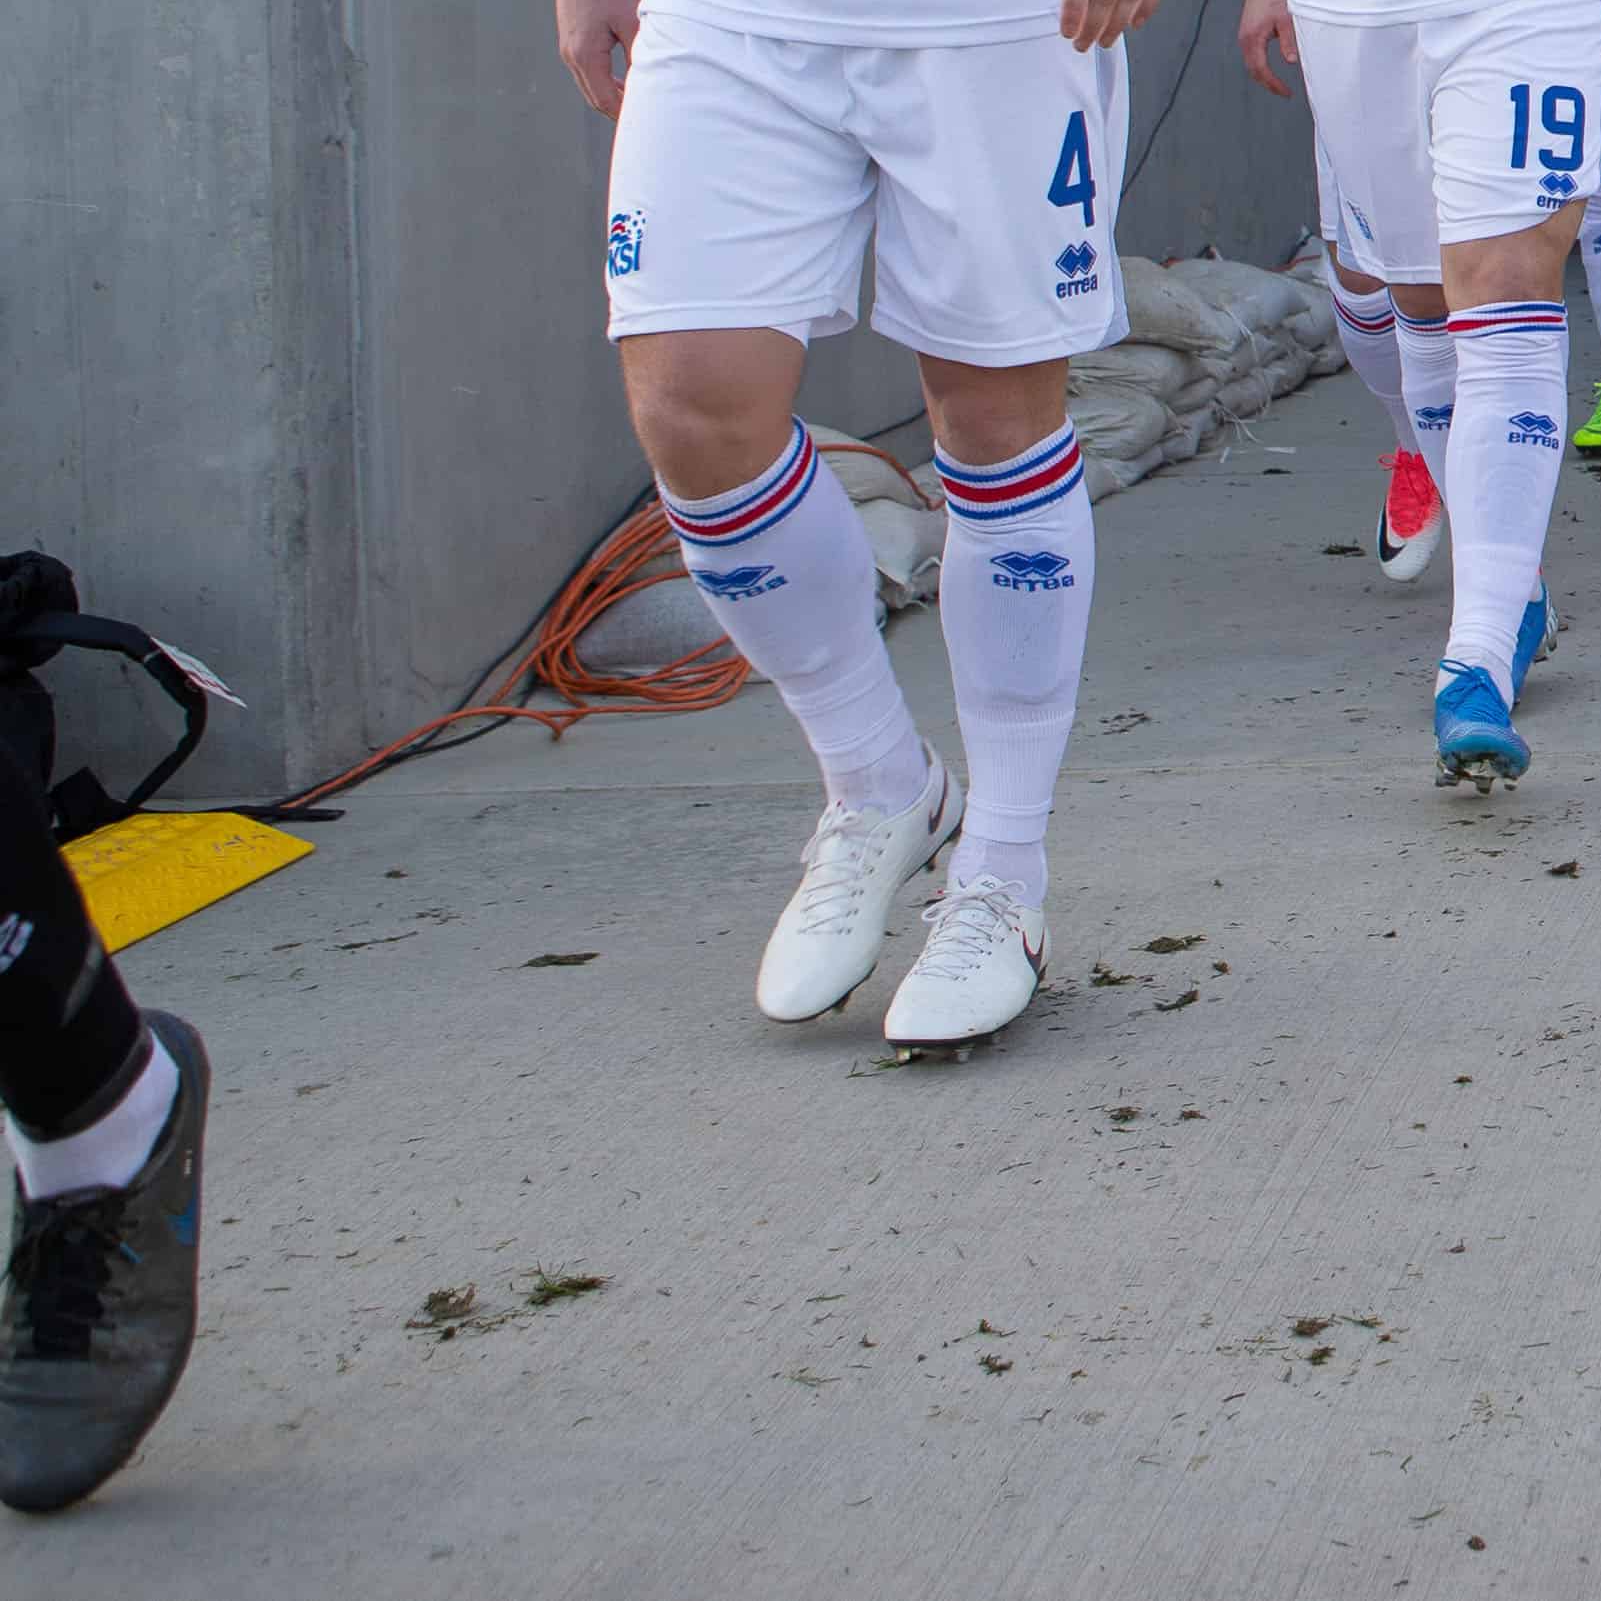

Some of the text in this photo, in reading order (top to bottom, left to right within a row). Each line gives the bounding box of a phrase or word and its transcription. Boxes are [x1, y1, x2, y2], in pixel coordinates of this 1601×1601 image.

[1509, 83, 1586, 171] 19
[1047, 110, 1097, 227] 4
[1056, 274, 1098, 299] errea
[1417, 421, 1451, 431] err
[1508, 431, 1560, 449] errea
[992, 572, 1075, 592] errea
